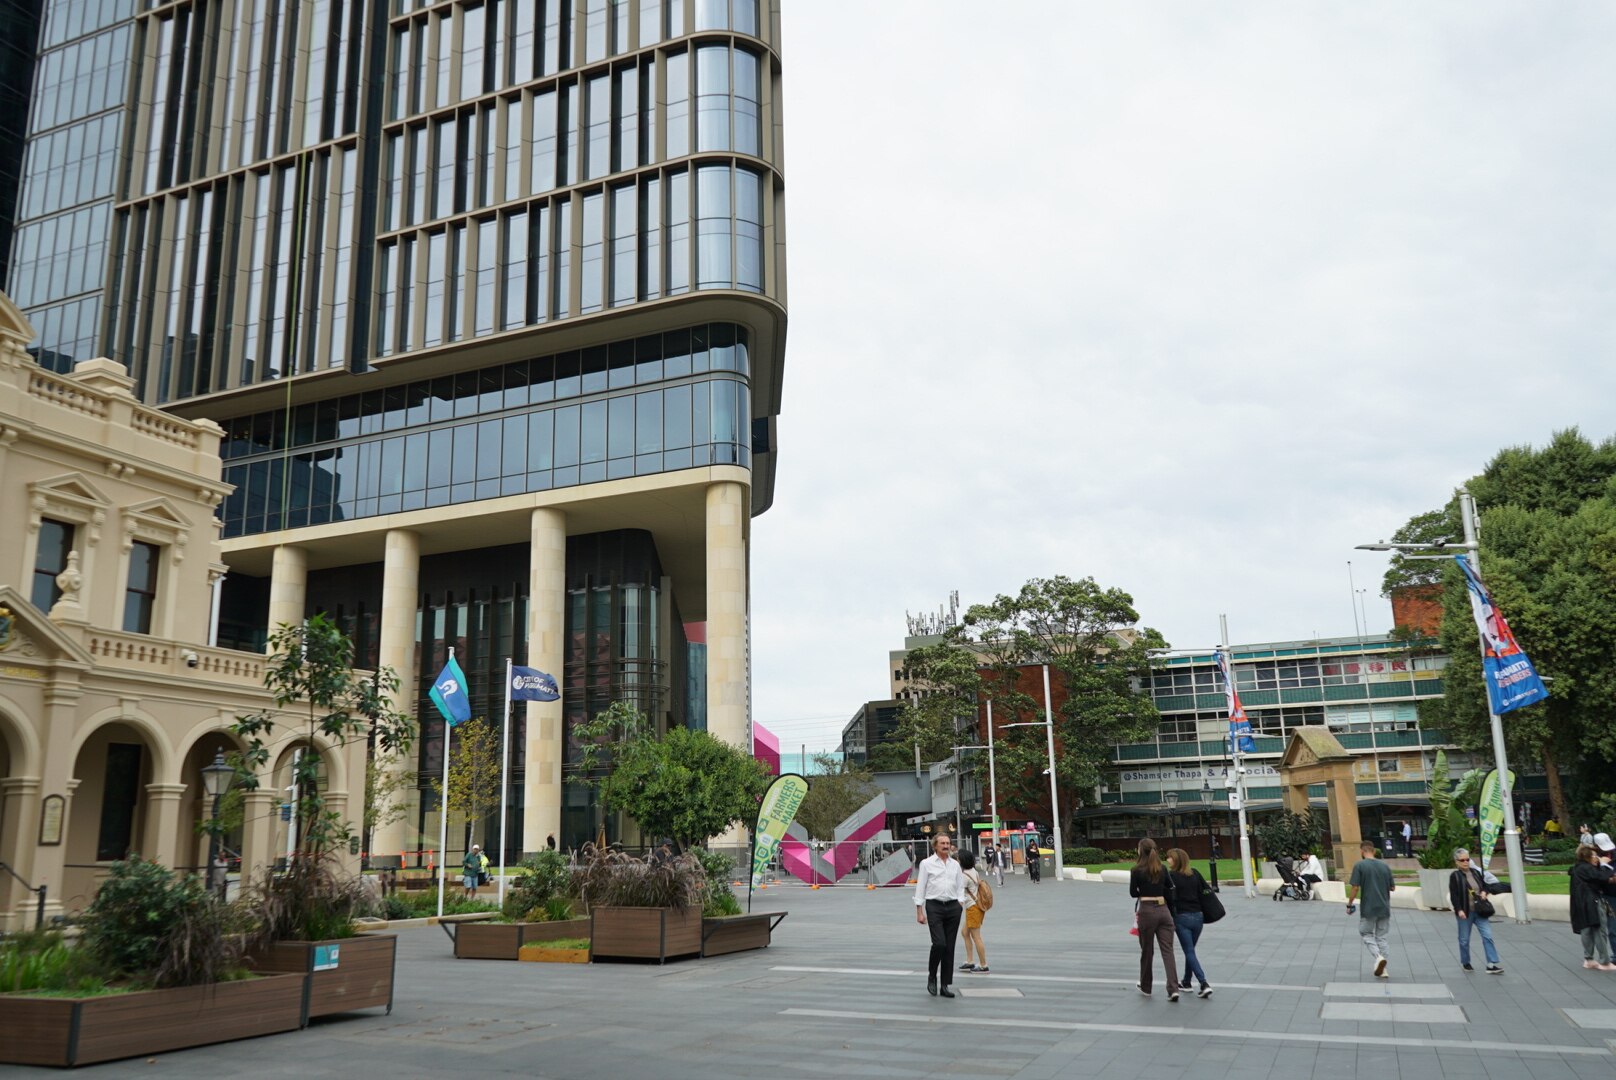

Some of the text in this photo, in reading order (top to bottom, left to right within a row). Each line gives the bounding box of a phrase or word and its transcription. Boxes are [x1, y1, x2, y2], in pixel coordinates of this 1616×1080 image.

[1494, 660, 1530, 680] PAMATTA
[524, 682, 555, 694] PARRAMATT
[1133, 772, 1171, 780] Shamser
[1174, 769, 1202, 779] Thapa
[1207, 768, 1215, 776] &
[771, 779, 796, 821] FARMERS
[781, 787, 805, 826] MARKET
